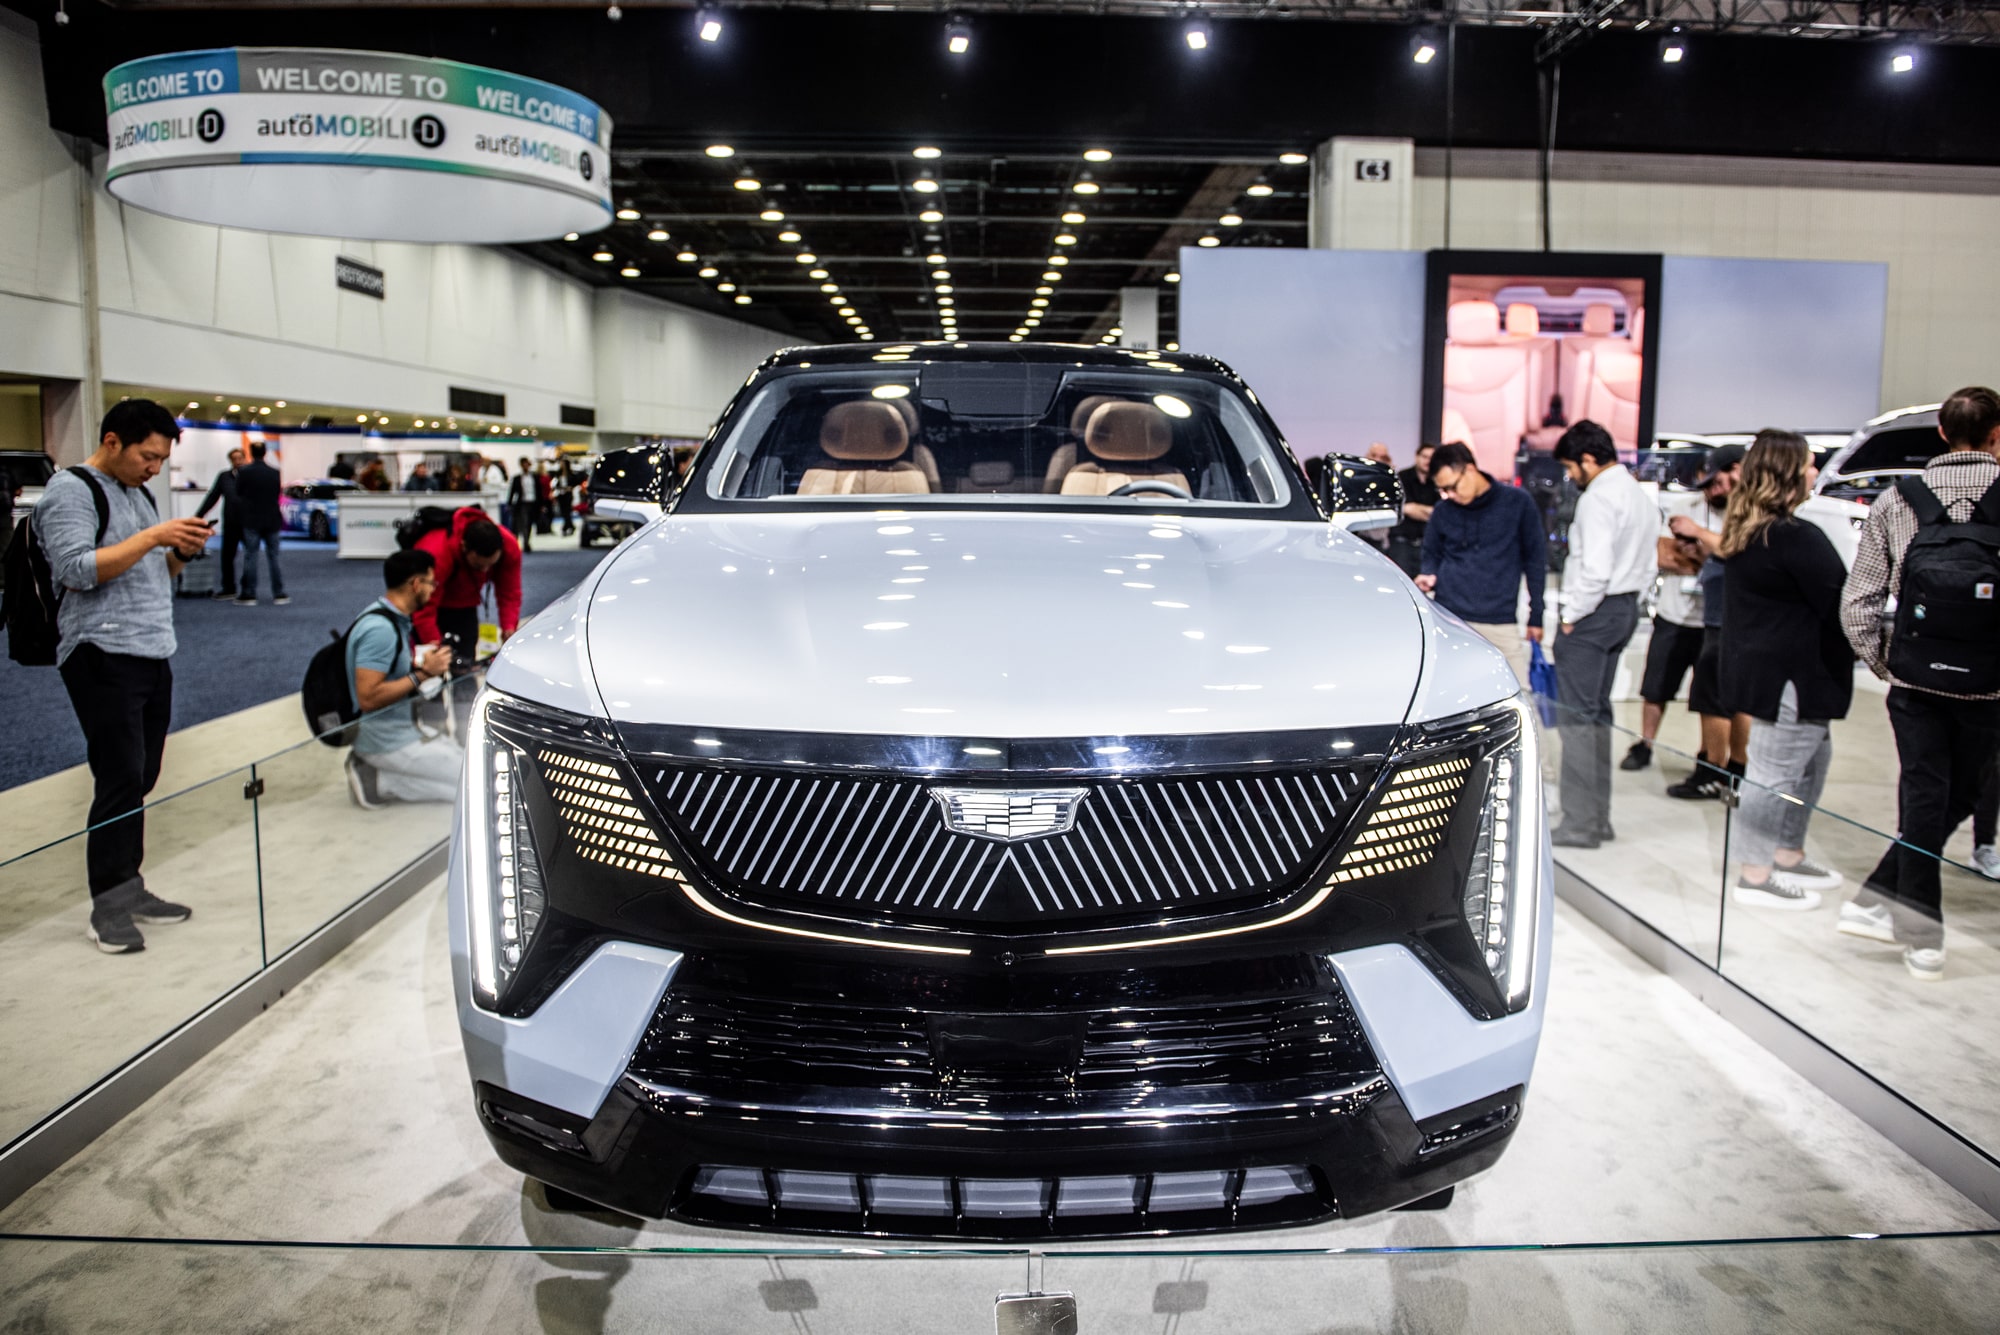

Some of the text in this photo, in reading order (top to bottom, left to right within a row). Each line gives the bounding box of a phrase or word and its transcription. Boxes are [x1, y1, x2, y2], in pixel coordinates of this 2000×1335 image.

[112, 69, 225, 105] WELCOME TO
[256, 67, 448, 100] WELCOME TO
[475, 85, 595, 139] WELCOME TO
